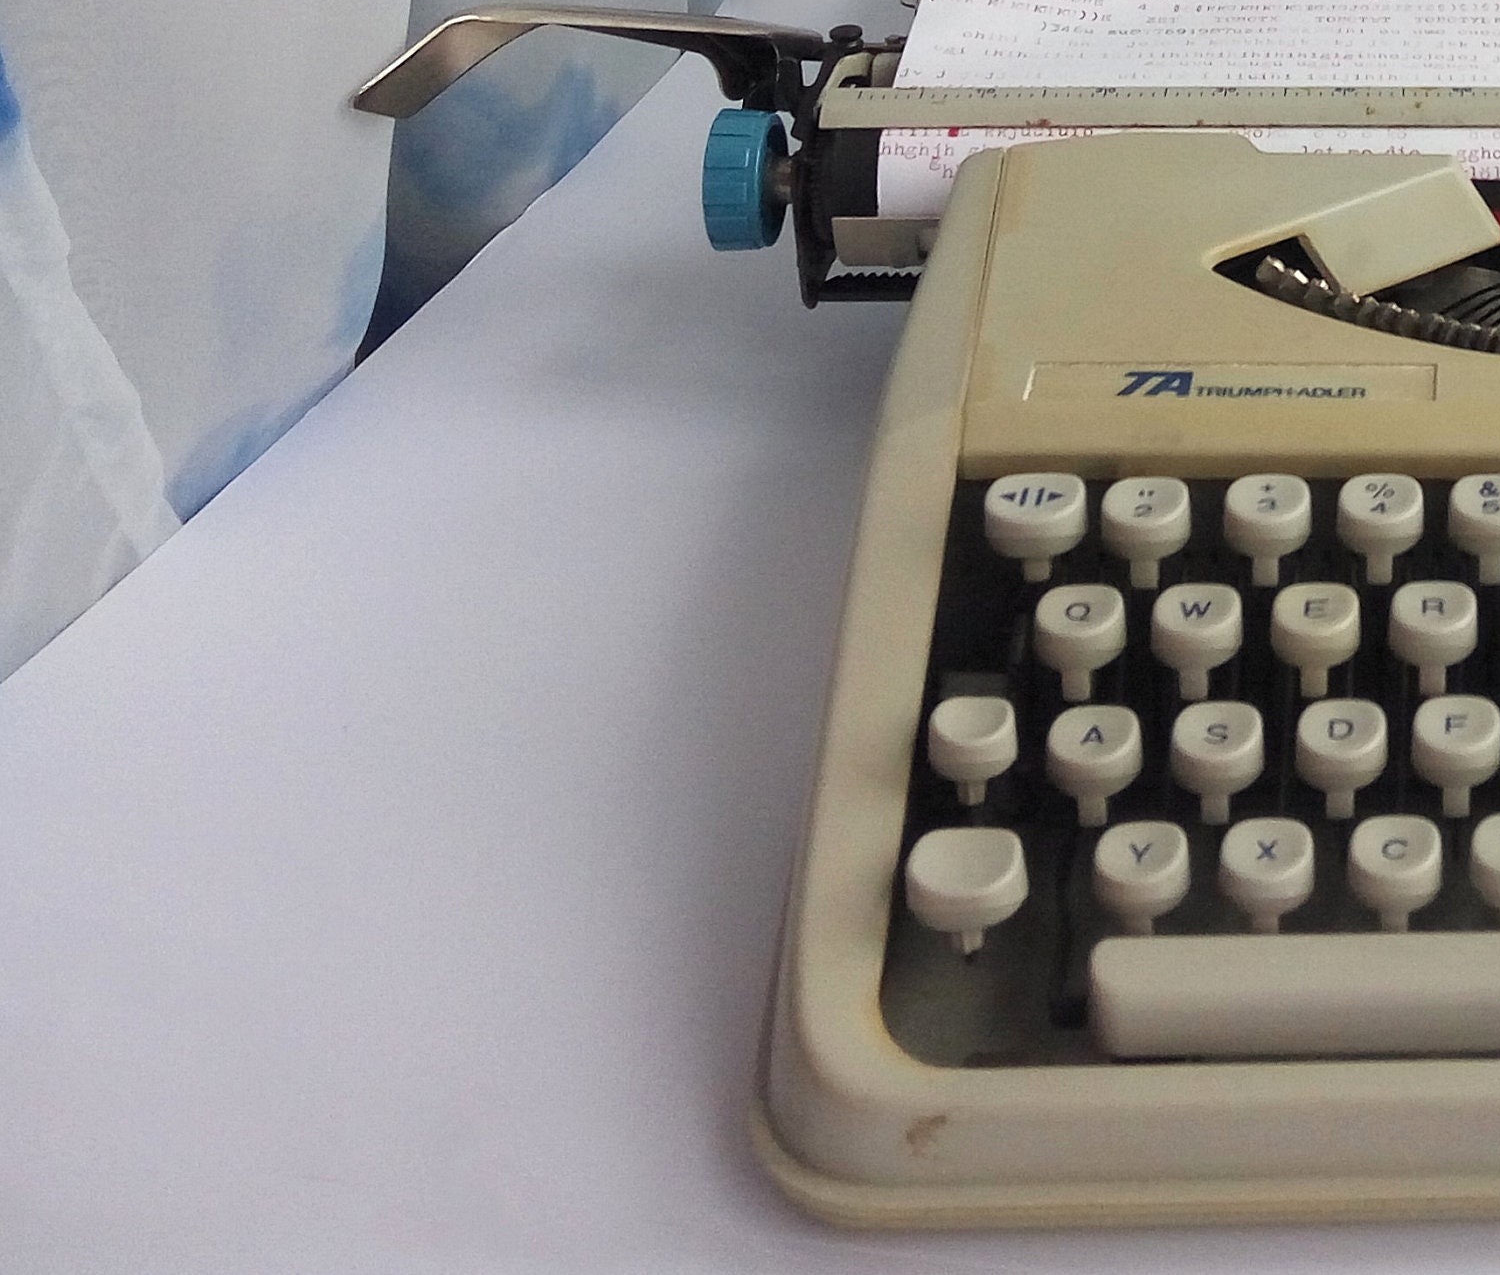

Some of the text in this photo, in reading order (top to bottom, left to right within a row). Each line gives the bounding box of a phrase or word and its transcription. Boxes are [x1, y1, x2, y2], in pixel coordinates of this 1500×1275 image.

[1117, 371, 1195, 397] TA
[1064, 602, 1092, 622] Q
[1180, 600, 1212, 620] W
[1303, 599, 1327, 618] E
[1421, 597, 1445, 616] R
[1080, 725, 1105, 746] A
[1206, 723, 1229, 745] S
[1327, 718, 1355, 741] D
[1444, 715, 1466, 734] F
[1129, 843, 1151, 864] Y
[1256, 840, 1278, 861] X
[1381, 838, 1408, 861] C
